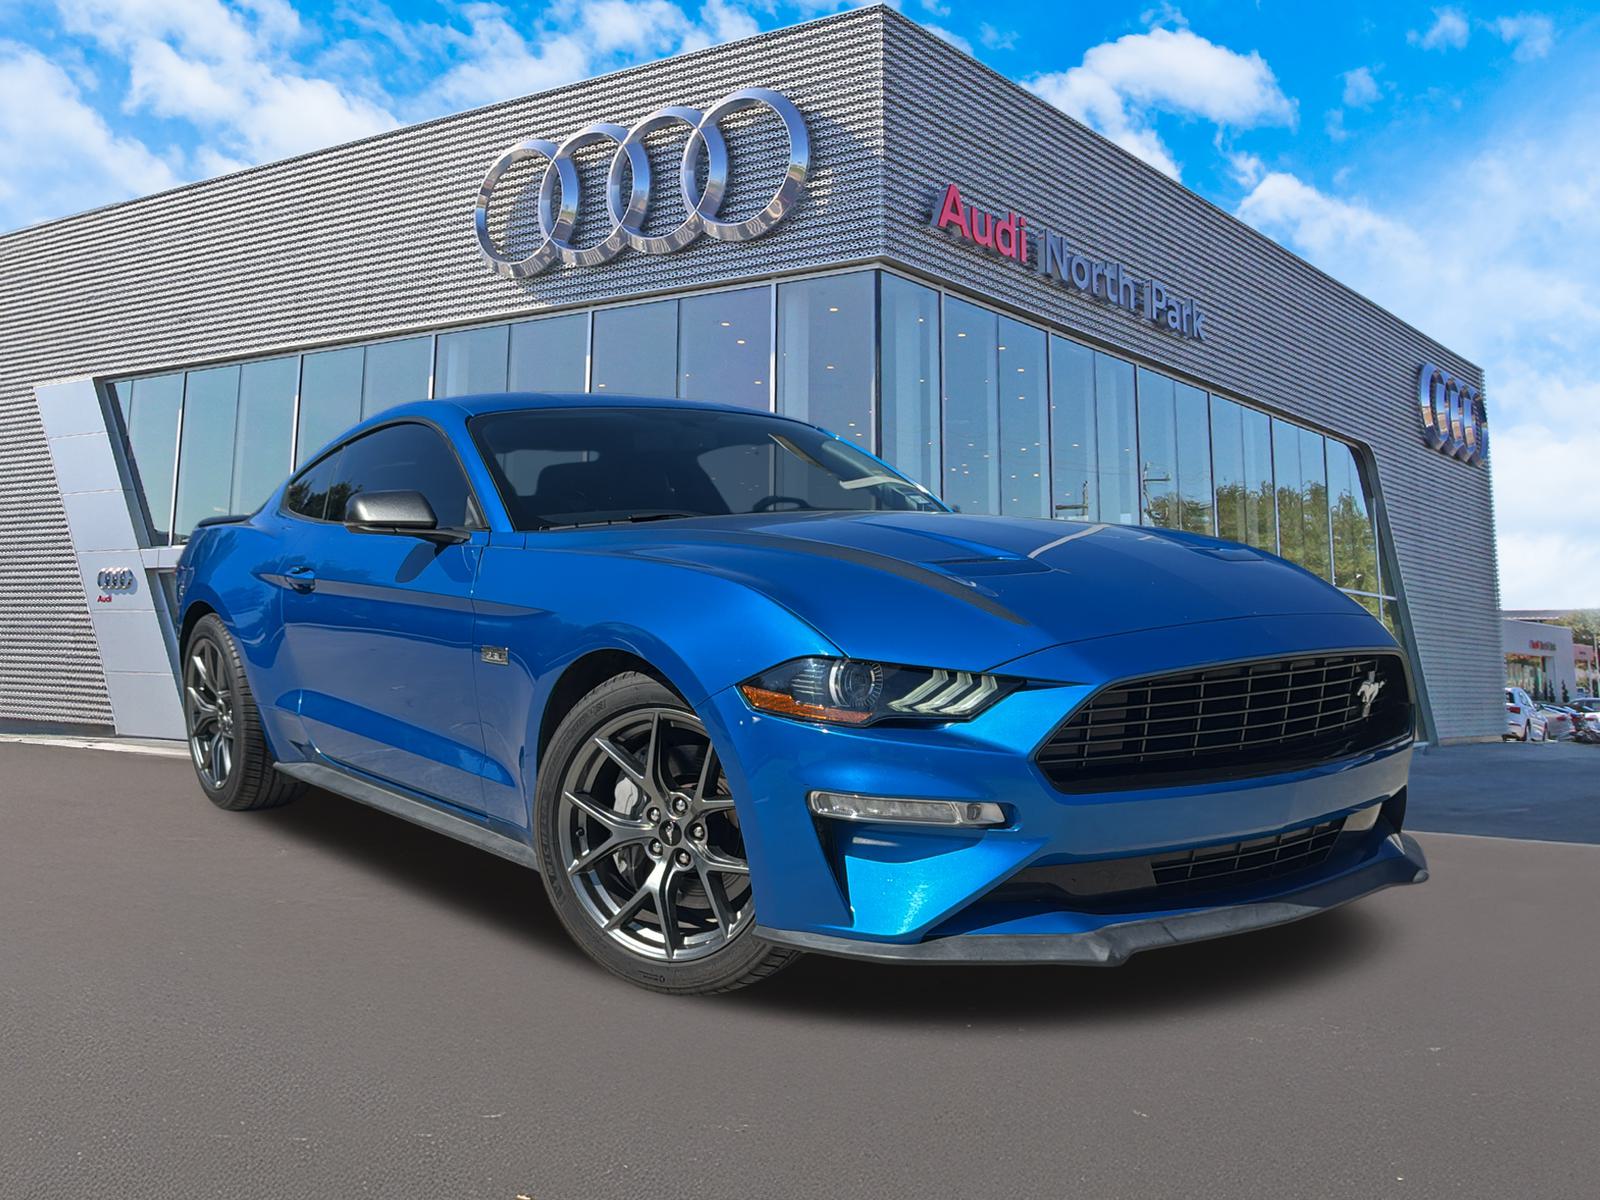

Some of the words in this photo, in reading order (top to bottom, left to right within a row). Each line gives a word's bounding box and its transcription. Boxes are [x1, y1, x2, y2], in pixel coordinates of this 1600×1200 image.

[934, 183, 1028, 263] Audi
[1042, 231, 1137, 311] North
[1147, 279, 1206, 340] Park
